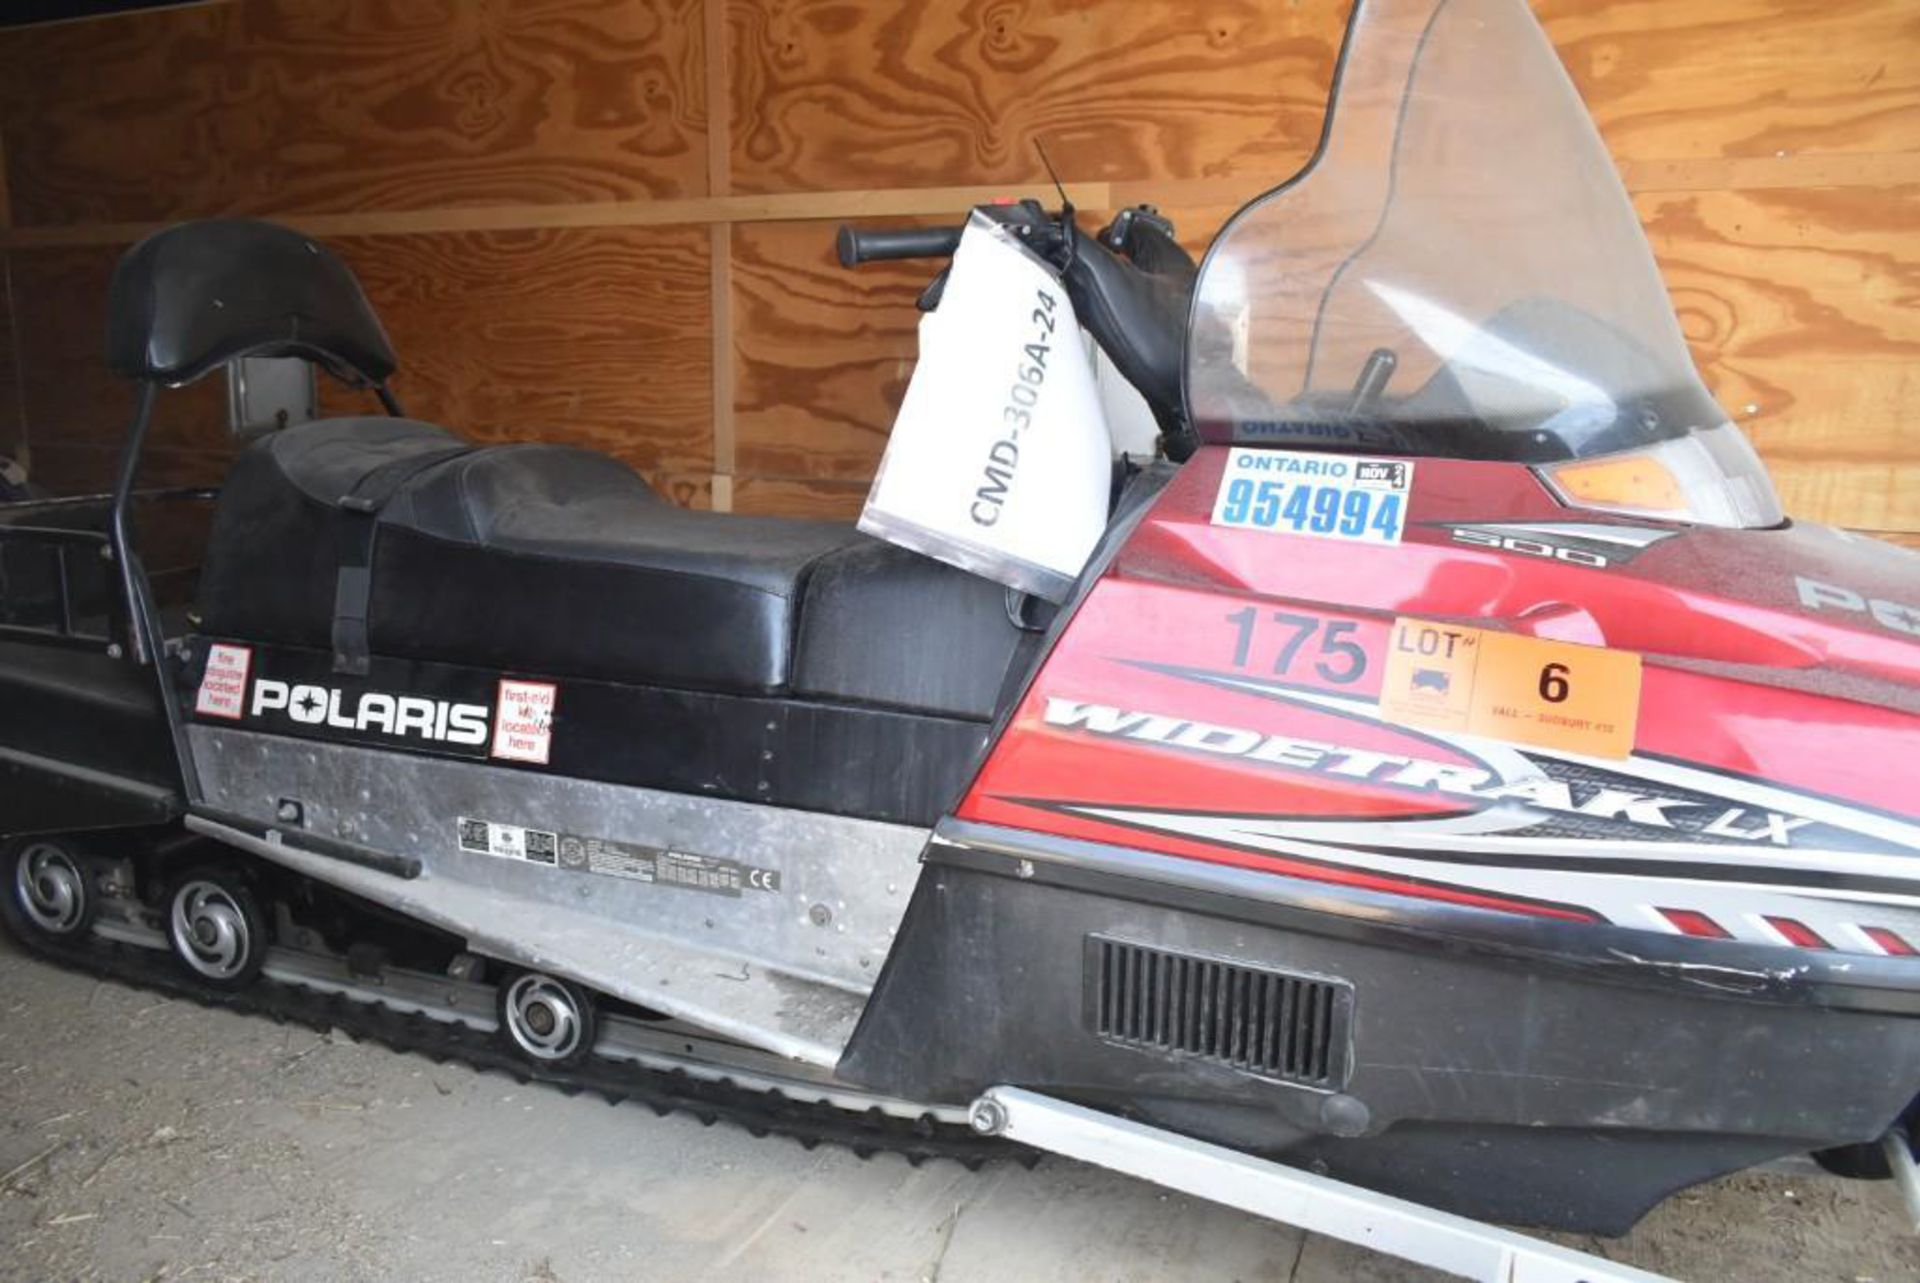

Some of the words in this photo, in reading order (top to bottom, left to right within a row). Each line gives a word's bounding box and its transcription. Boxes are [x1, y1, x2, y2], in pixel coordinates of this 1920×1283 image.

[970, 288, 1058, 528] CMD-306A-24
[1237, 454, 1348, 478] ONTARIO
[1360, 467, 1389, 479] NOV
[1222, 478, 1401, 541] 954994
[1453, 528, 1607, 567] 500
[1224, 606, 1368, 684] 175
[1397, 625, 1462, 659] LOT
[1538, 662, 1571, 703] 6
[251, 678, 489, 746] POLARIS
[1044, 697, 1706, 830] WIDETRAK
[1702, 807, 1814, 846] LX
